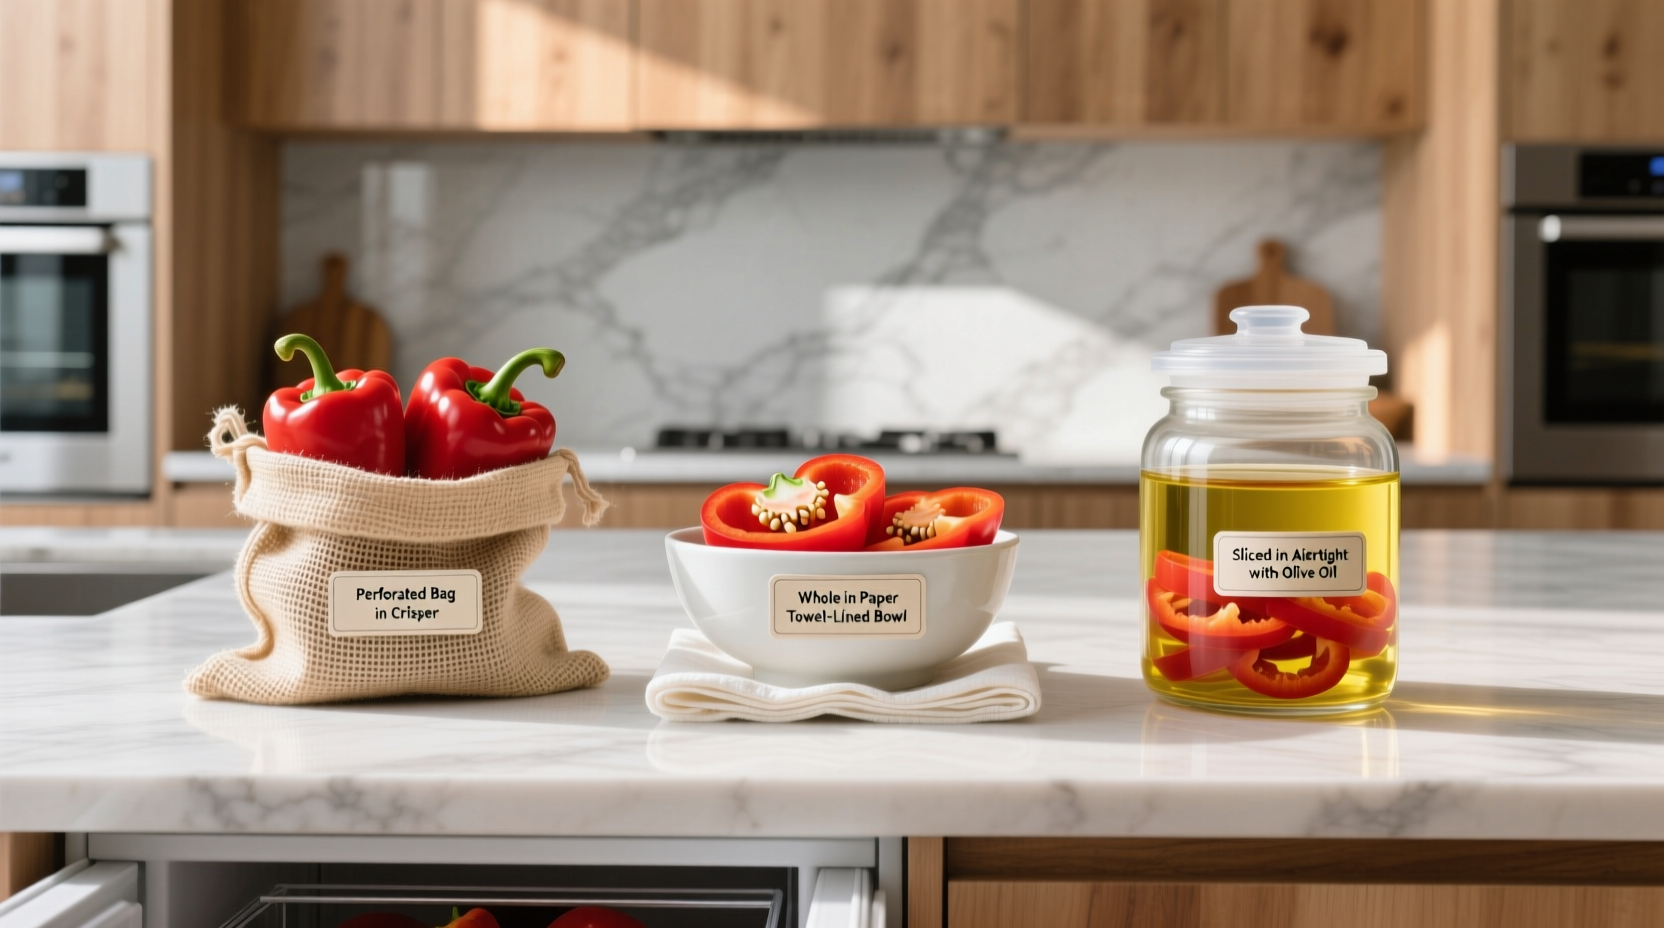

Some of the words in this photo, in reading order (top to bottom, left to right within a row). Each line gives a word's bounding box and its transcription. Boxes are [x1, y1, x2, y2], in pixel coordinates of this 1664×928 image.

[1232, 547, 1272, 561] Sliced
[1276, 548, 1288, 561] in
[1249, 565, 1279, 579] with
[1282, 565, 1316, 579] Olive
[1319, 565, 1337, 579] Oil
[356, 586, 427, 600] Perforated
[431, 586, 456, 603] Bag
[798, 590, 841, 604] Whole
[844, 590, 856, 604] in
[860, 590, 899, 608] Paper
[375, 607, 387, 619] in
[786, 609, 870, 623] Towel-Lined
[874, 609, 907, 623] Bowl
